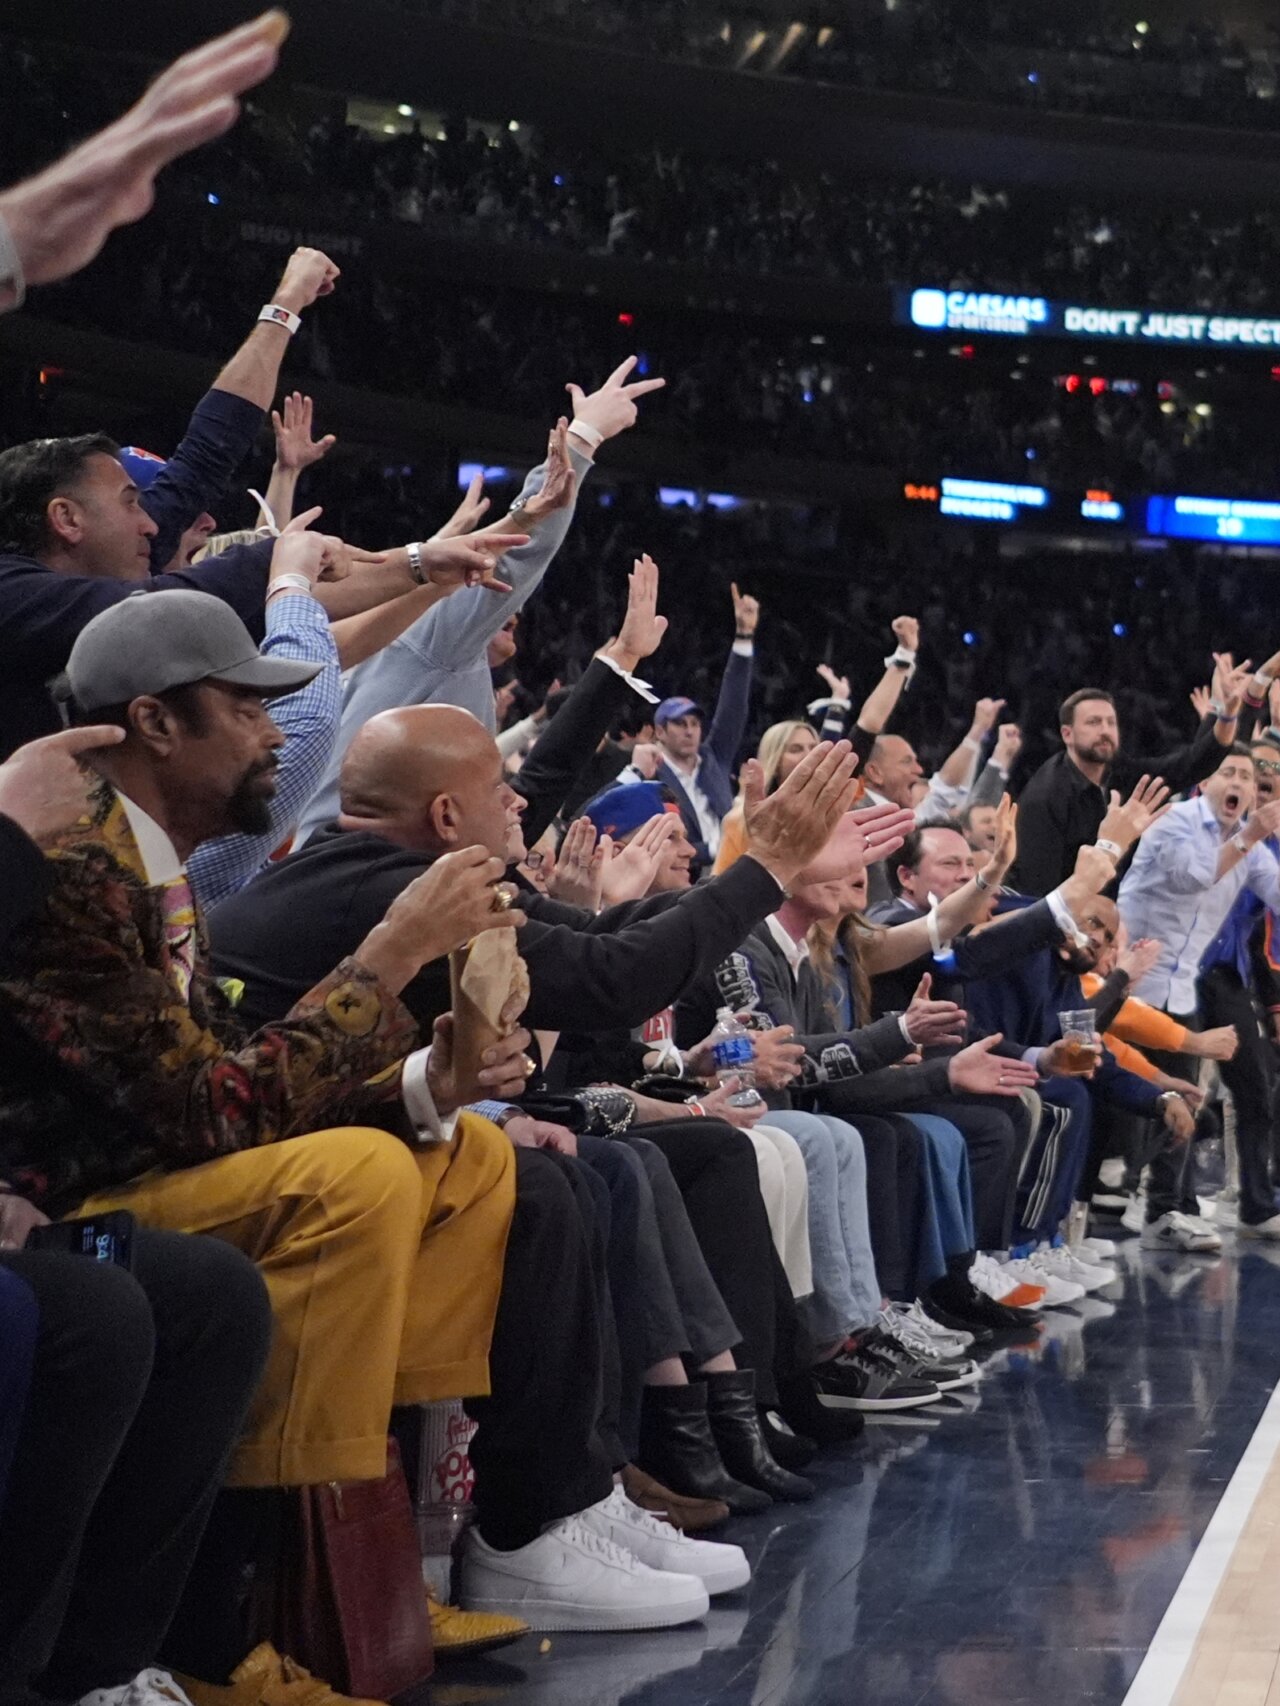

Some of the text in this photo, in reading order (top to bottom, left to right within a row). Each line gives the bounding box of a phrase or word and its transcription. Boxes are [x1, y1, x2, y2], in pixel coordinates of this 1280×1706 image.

[947, 291, 1046, 322] CAESARS
[1064, 307, 1141, 336] DON'T
[1141, 313, 1207, 340] JUST
